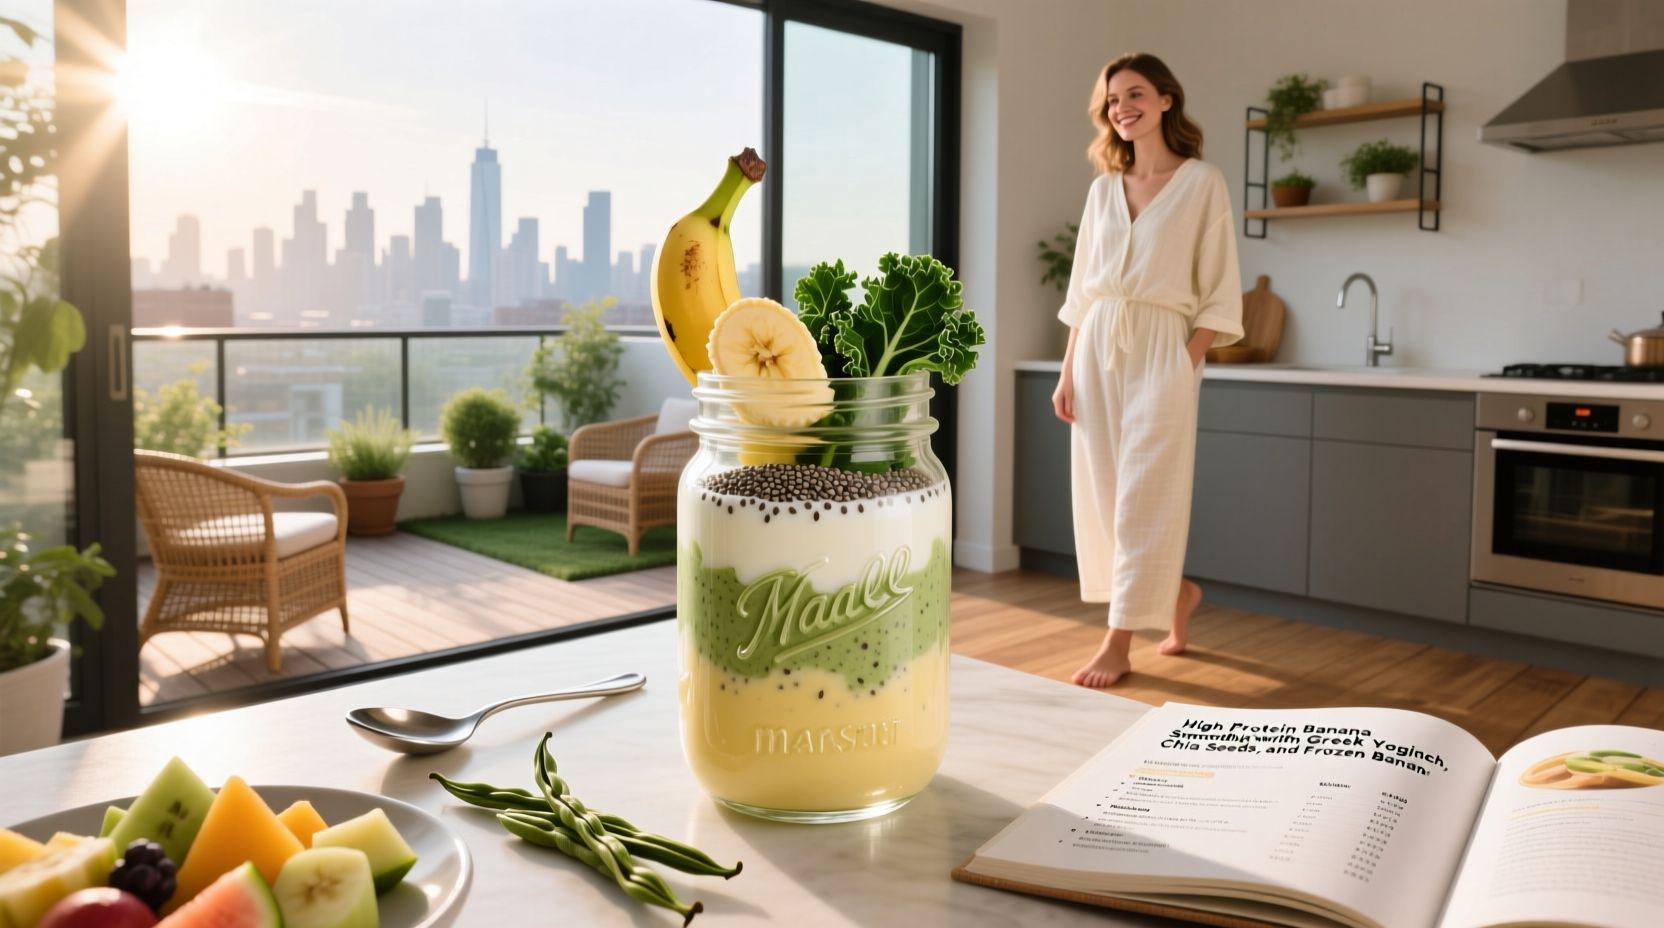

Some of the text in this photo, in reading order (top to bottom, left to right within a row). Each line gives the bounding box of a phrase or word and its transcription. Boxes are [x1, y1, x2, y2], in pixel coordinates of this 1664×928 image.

[1182, 719, 1372, 736] High Protein Banana
[1160, 739, 1200, 751] Chia
[1205, 742, 1261, 755] Seeds,
[1265, 745, 1300, 755] and
[1303, 746, 1366, 758] Frozen
[1307, 735, 1364, 746] Greek
